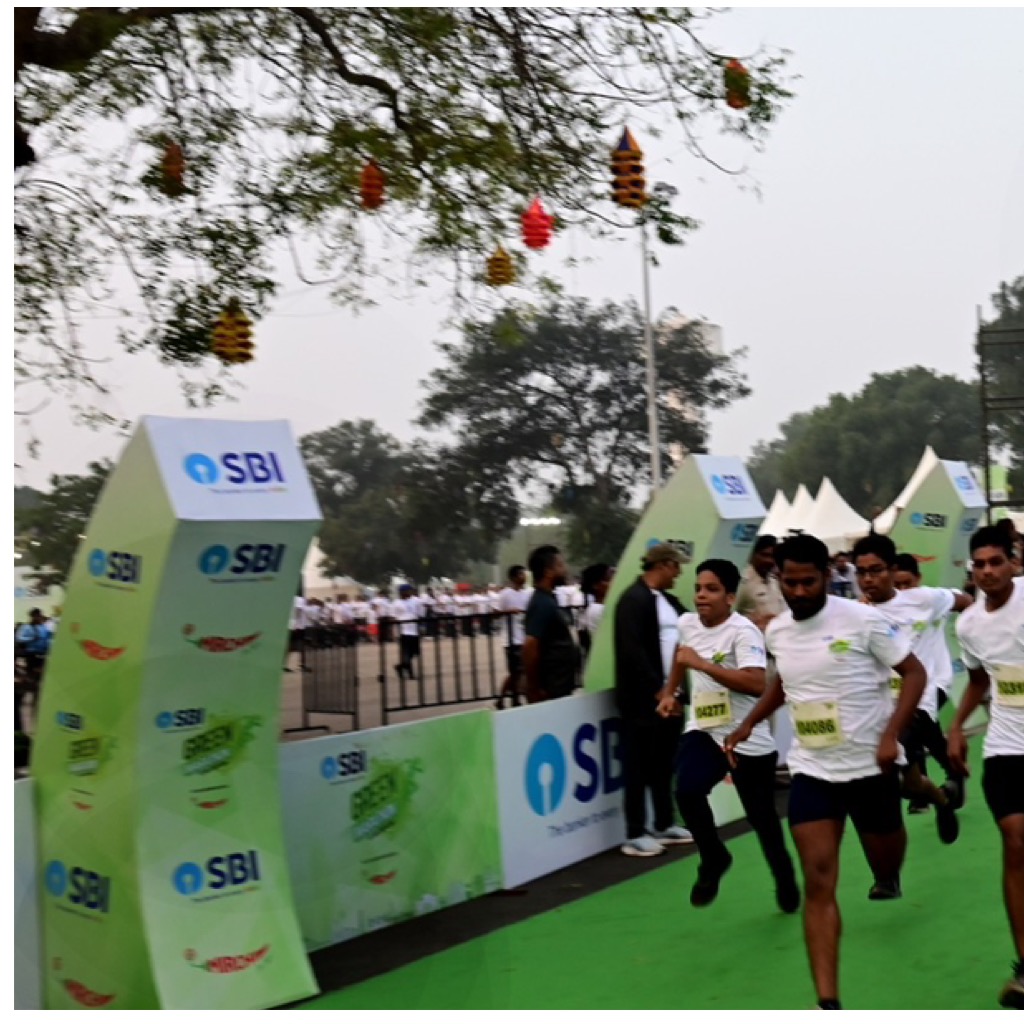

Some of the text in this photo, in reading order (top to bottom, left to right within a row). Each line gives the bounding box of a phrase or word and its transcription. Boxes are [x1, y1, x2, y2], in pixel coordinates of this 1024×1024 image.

[221, 452, 285, 484] SBI
[107, 551, 141, 585] SBI
[230, 543, 286, 573] SBI
[337, 749, 367, 776] SBI
[572, 717, 624, 804] SB
[205, 849, 260, 889] SBI
[68, 866, 110, 913] SBI
